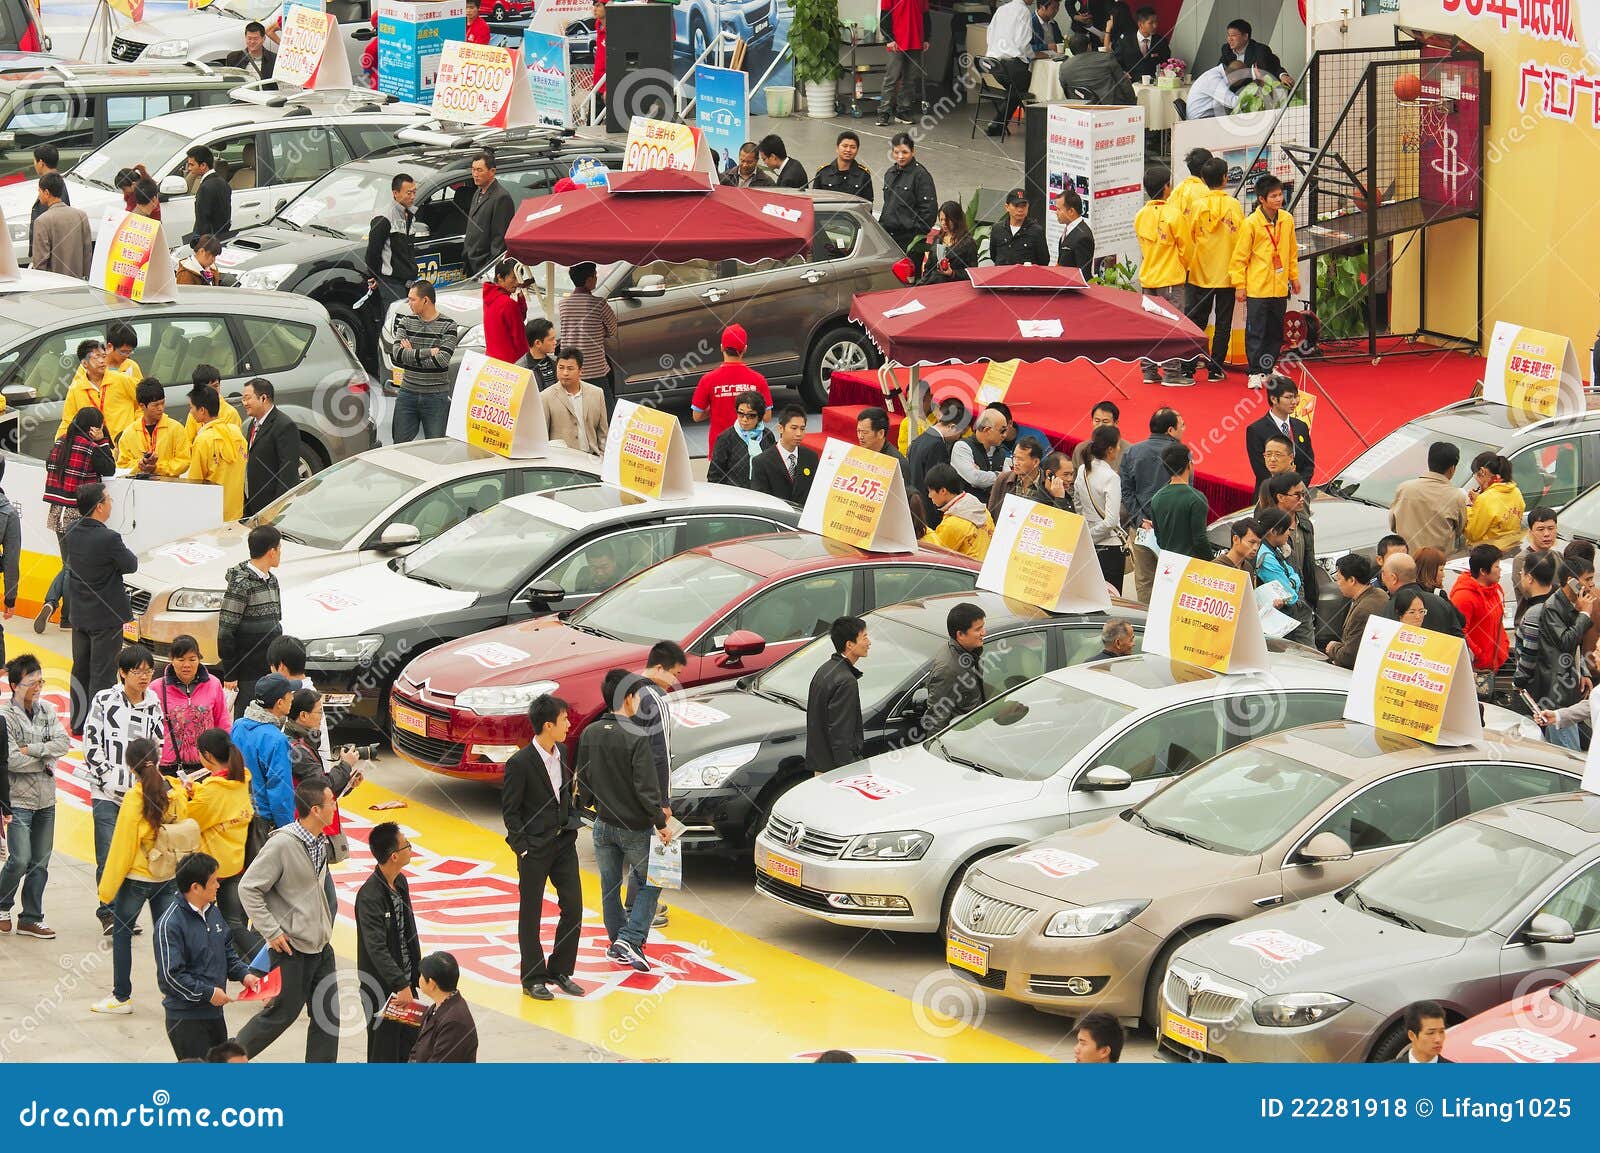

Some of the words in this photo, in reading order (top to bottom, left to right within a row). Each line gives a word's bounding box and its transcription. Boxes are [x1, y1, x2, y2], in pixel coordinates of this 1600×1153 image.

[1520, 64, 1600, 124] 广汇广
[1510, 356, 1555, 379] 现车现提!
[470, 404, 514, 431] 巨惠58200元
[832, 474, 885, 503] 巨惠2.5万元
[1178, 593, 1235, 621] 最高巨惠5000元
